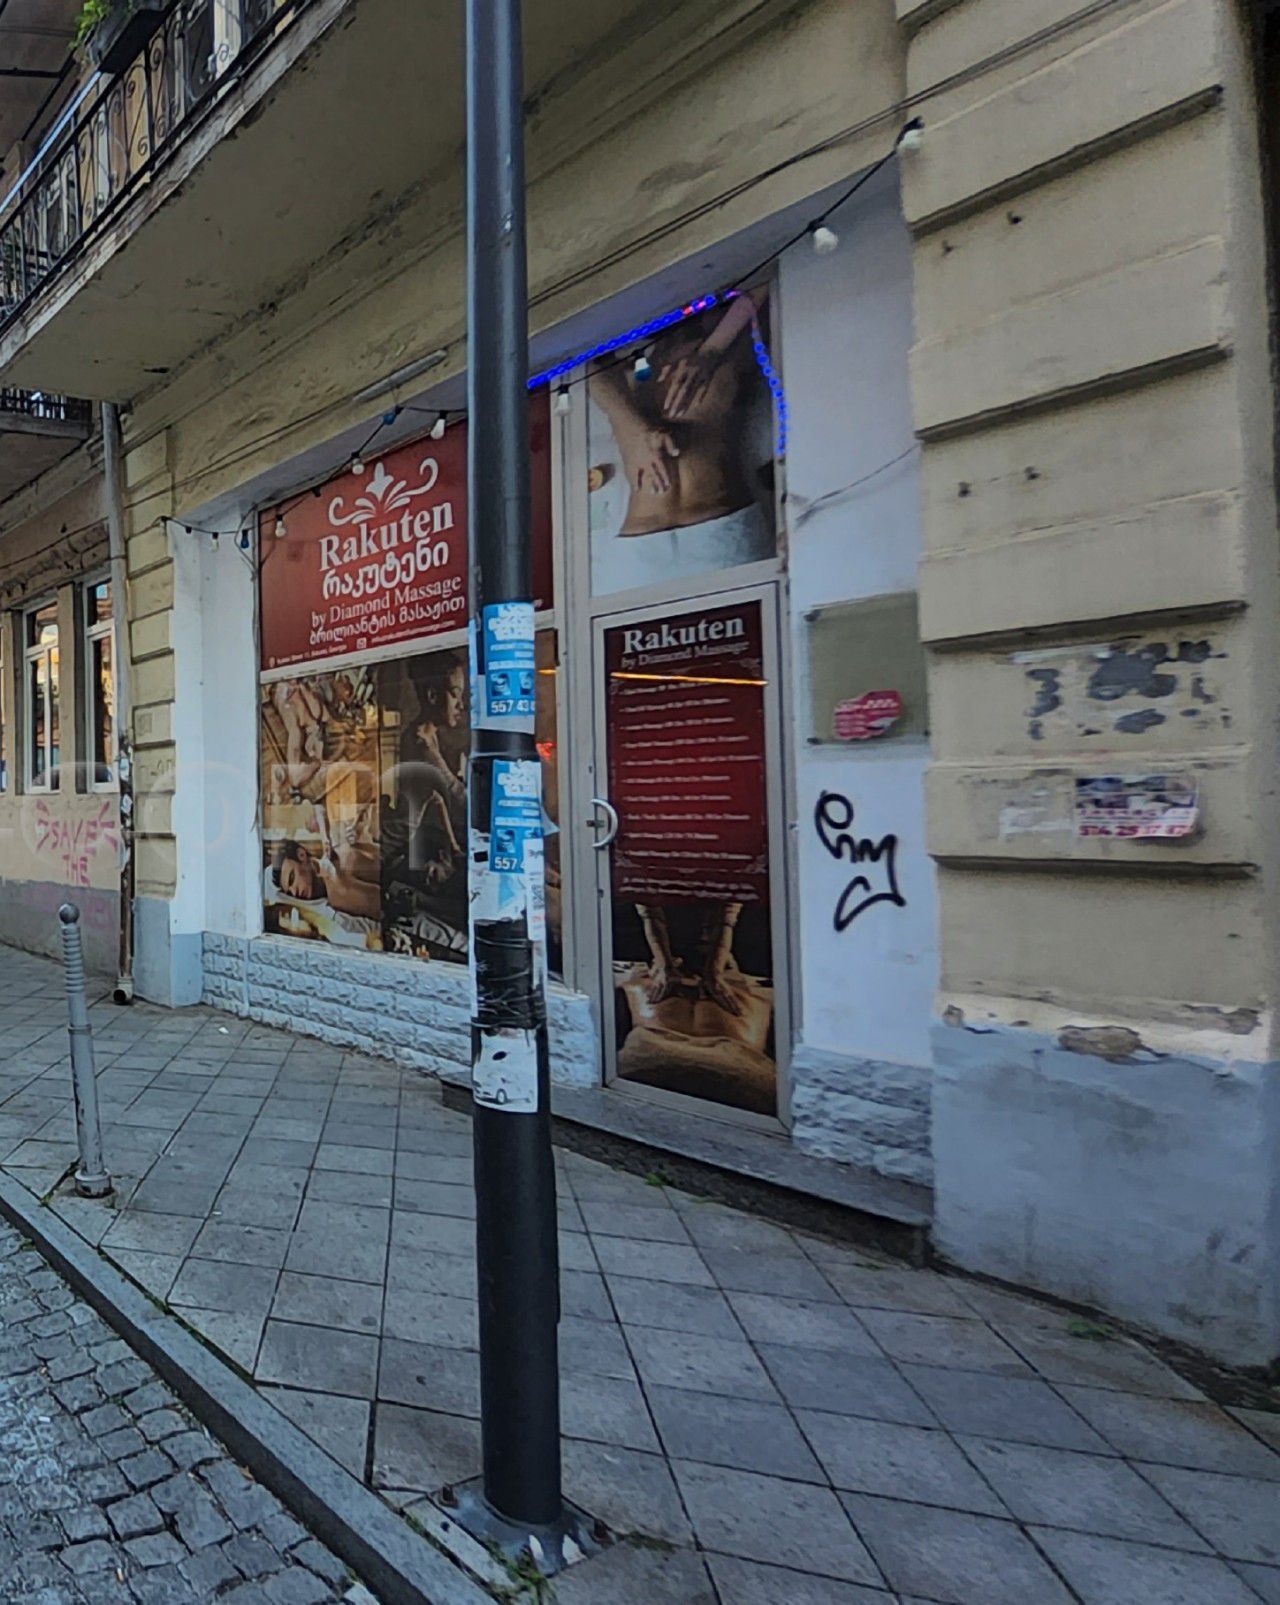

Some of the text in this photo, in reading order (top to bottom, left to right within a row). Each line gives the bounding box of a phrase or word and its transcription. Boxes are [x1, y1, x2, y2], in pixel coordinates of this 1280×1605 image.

[319, 502, 454, 571] Rakuten
[323, 537, 449, 599] რაკუტენი
[309, 611, 396, 645] ბრილიანტის
[399, 596, 466, 623] მასაჟით
[311, 576, 462, 632] by Diamond Massage
[622, 617, 745, 654] Rakuten
[491, 700, 514, 713] 557
[51, 818, 97, 856] SAVE
[62, 854, 91, 887] THE
[495, 856, 518, 870] 557
